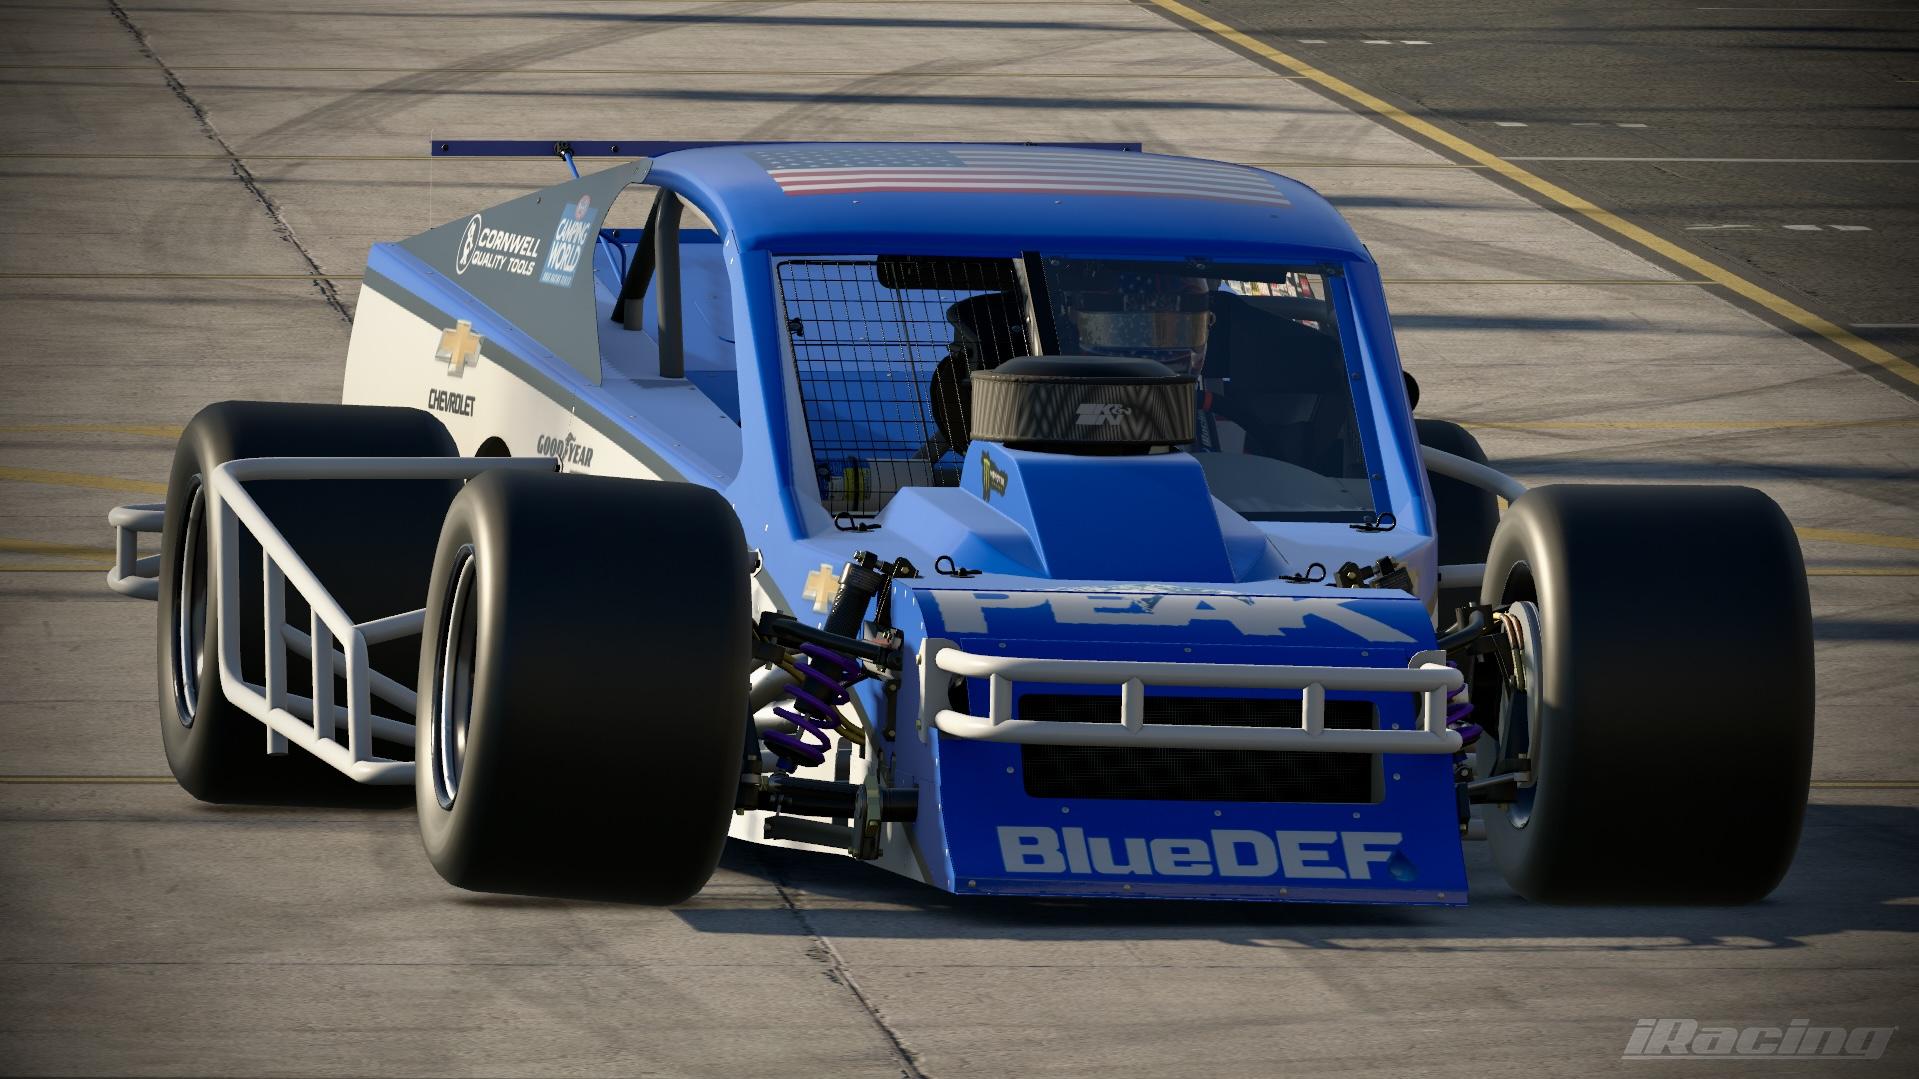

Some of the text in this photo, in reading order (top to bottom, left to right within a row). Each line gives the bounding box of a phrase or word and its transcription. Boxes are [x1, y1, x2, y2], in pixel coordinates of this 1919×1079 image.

[478, 228, 541, 258] CORNWELL
[555, 218, 590, 245] CAMPING
[471, 250, 536, 276] QUALITY TOOLS
[547, 240, 582, 272] WORLD
[428, 388, 476, 417] CHEVROLET
[931, 590, 1419, 643] PEAK
[996, 826, 1404, 880] BlueDEF
